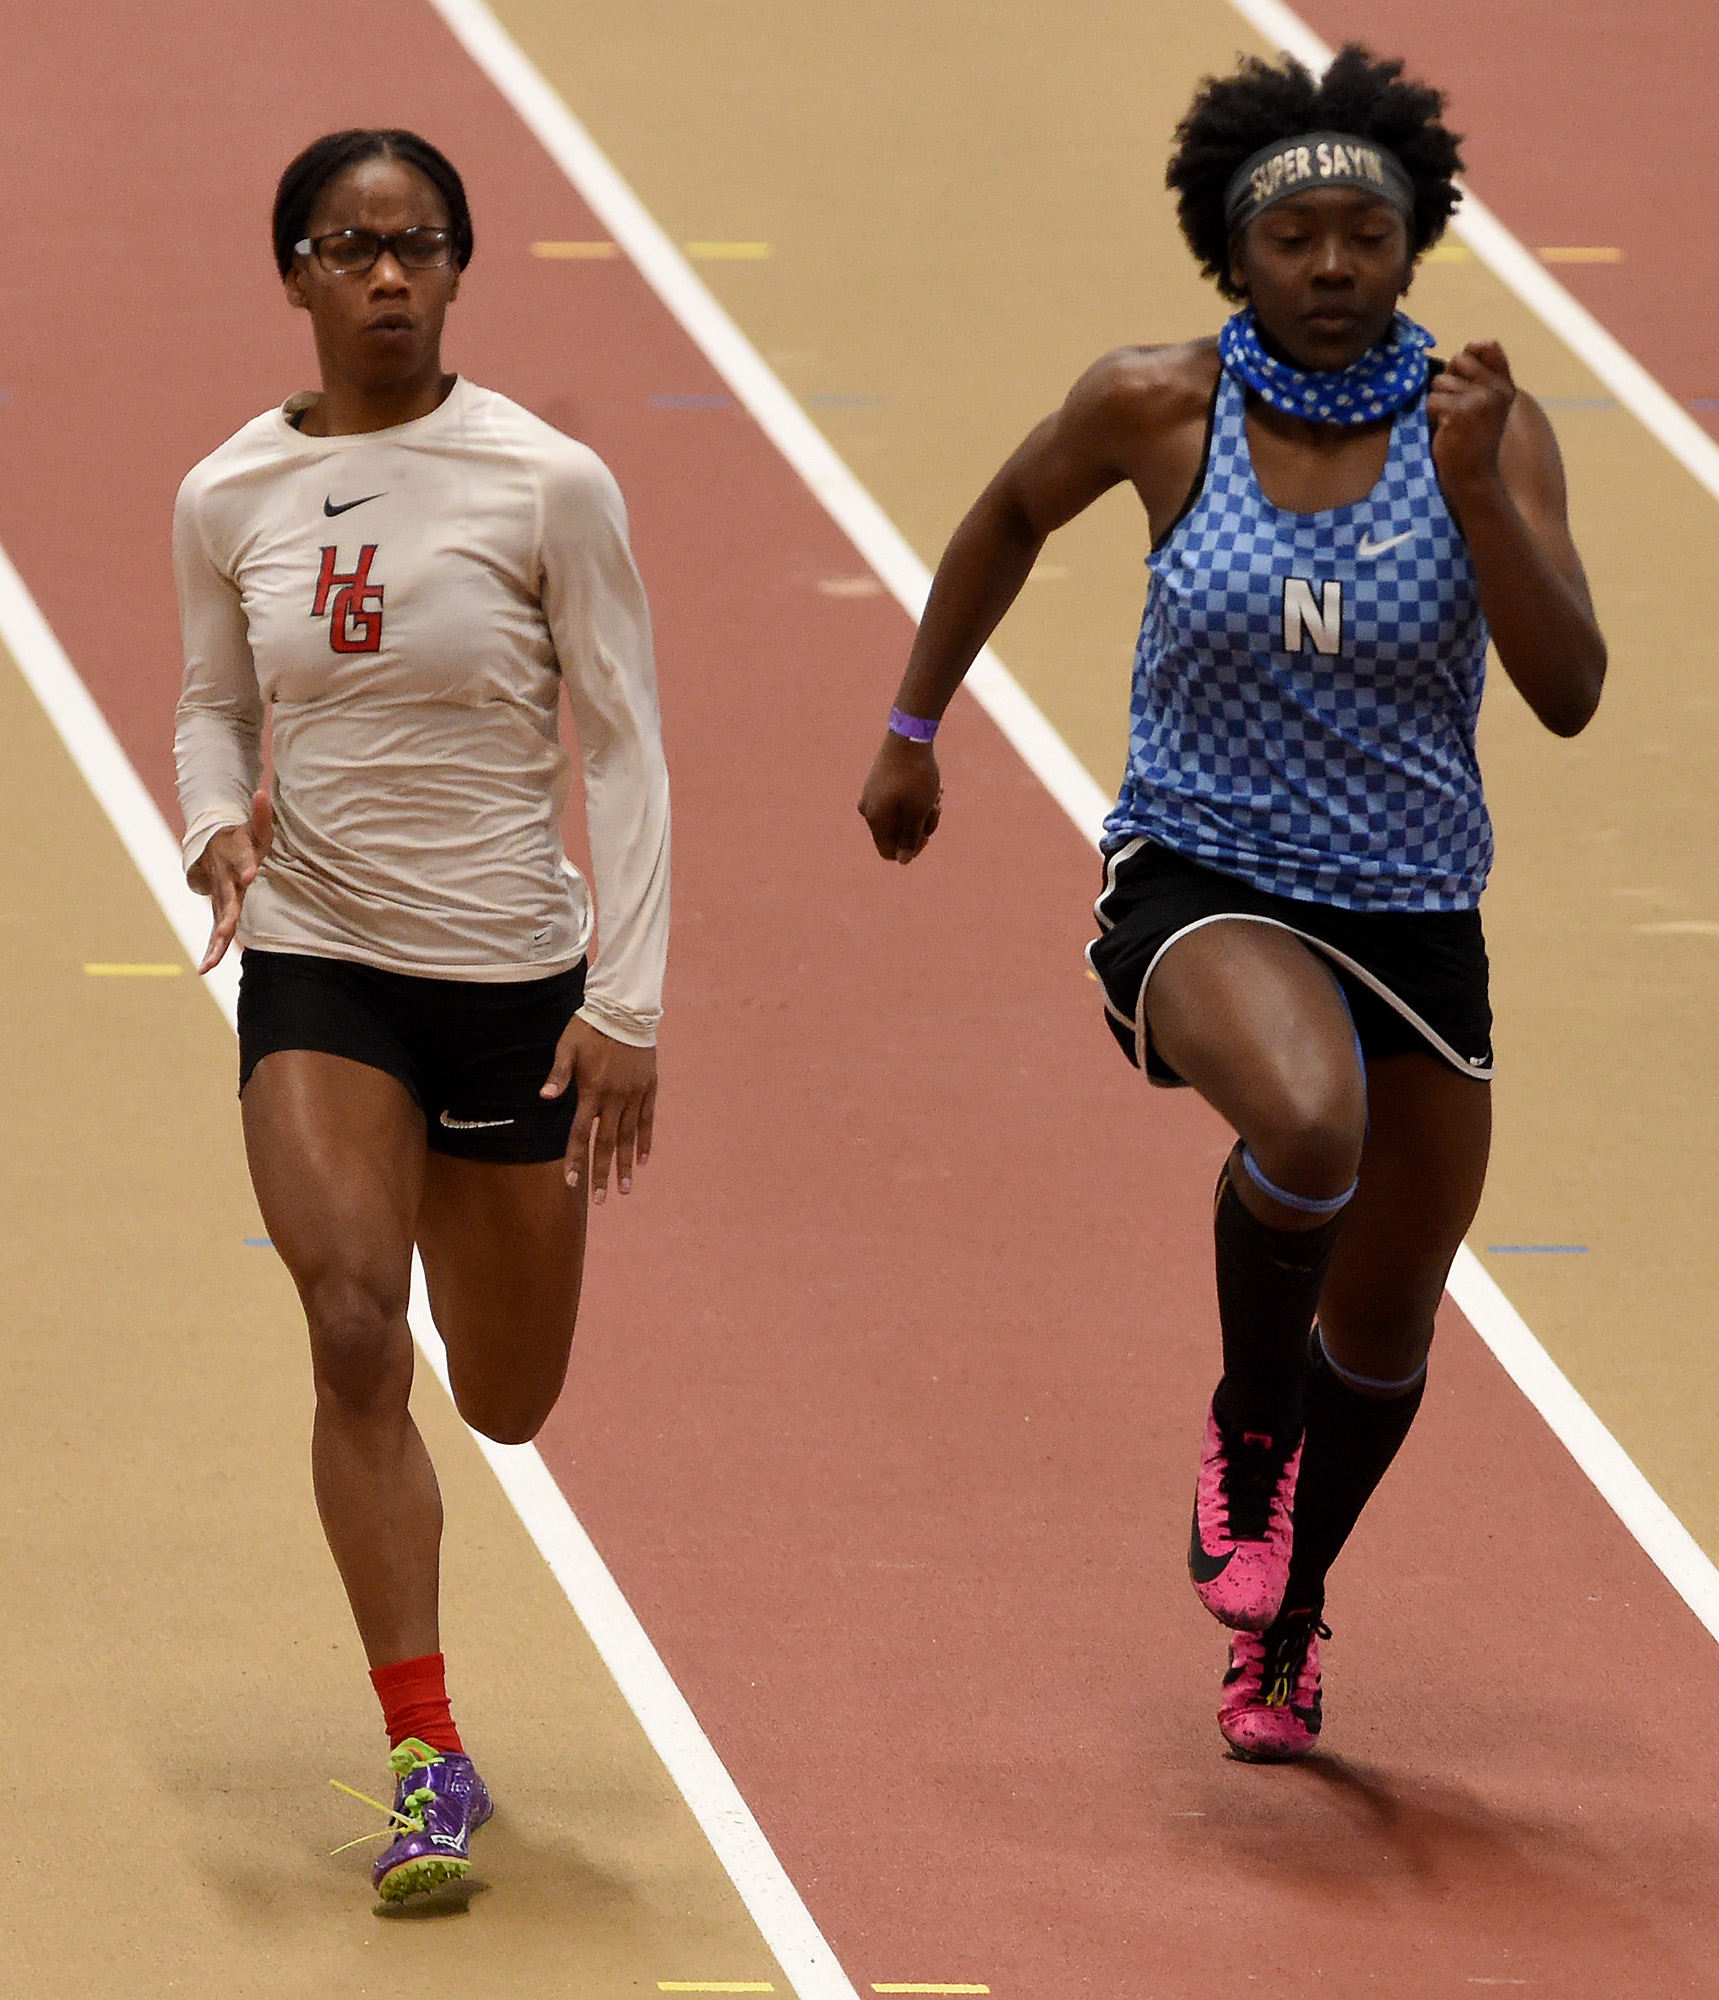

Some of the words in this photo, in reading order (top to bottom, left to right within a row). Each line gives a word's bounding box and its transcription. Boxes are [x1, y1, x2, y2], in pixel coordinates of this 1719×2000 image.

[1250, 146, 1312, 201] SUPER
[310, 544, 384, 653] HG
[1282, 577, 1343, 656] N
